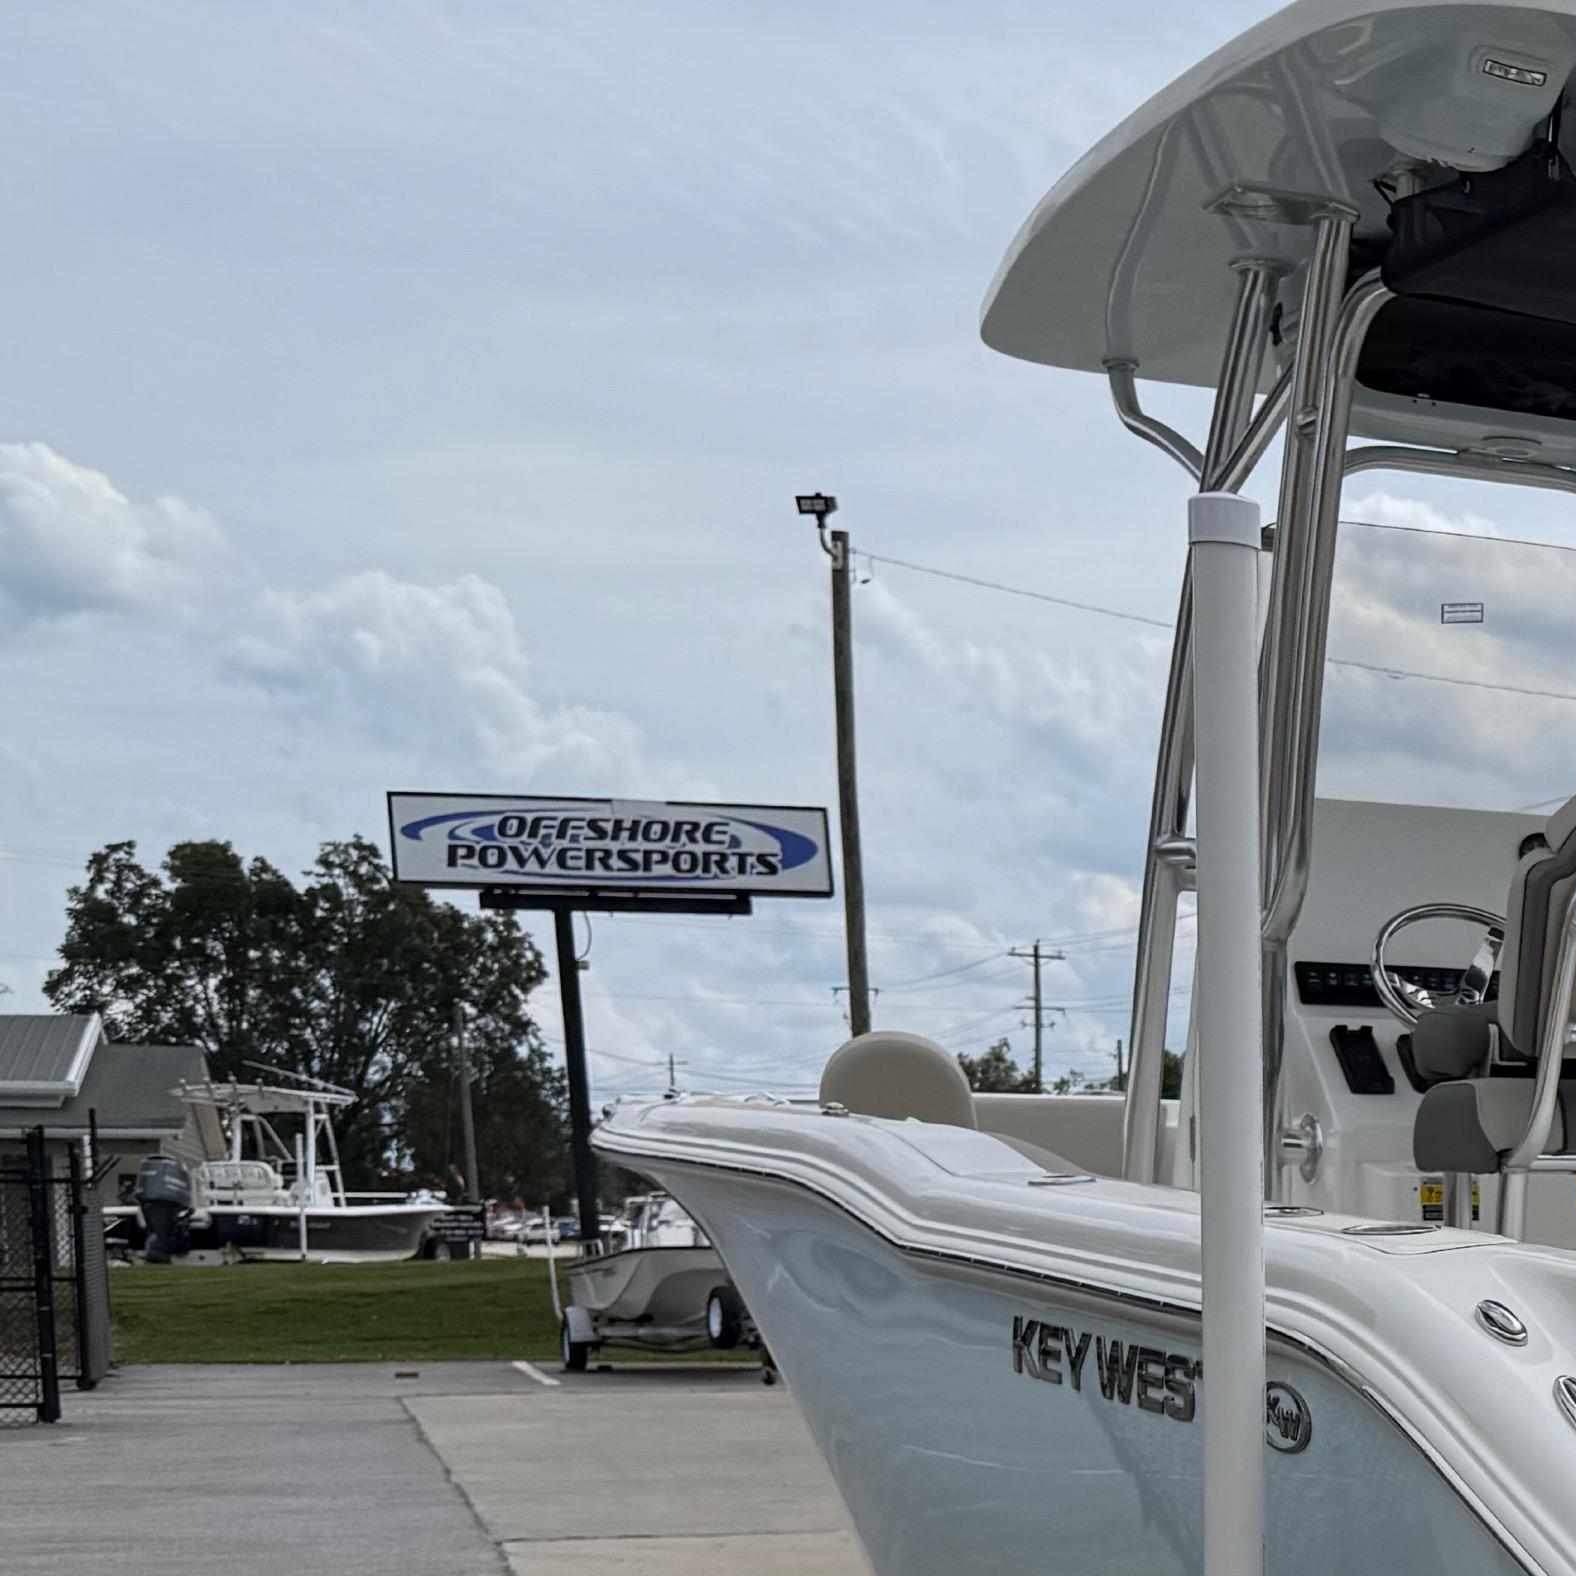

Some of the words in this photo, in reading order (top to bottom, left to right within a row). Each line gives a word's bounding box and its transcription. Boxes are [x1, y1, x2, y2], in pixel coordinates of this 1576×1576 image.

[497, 814, 731, 847] OFFSHORE
[446, 843, 780, 877] POWERSPORTS
[1012, 1315, 1092, 1393] KEY
[1096, 1334, 1204, 1423] WES
